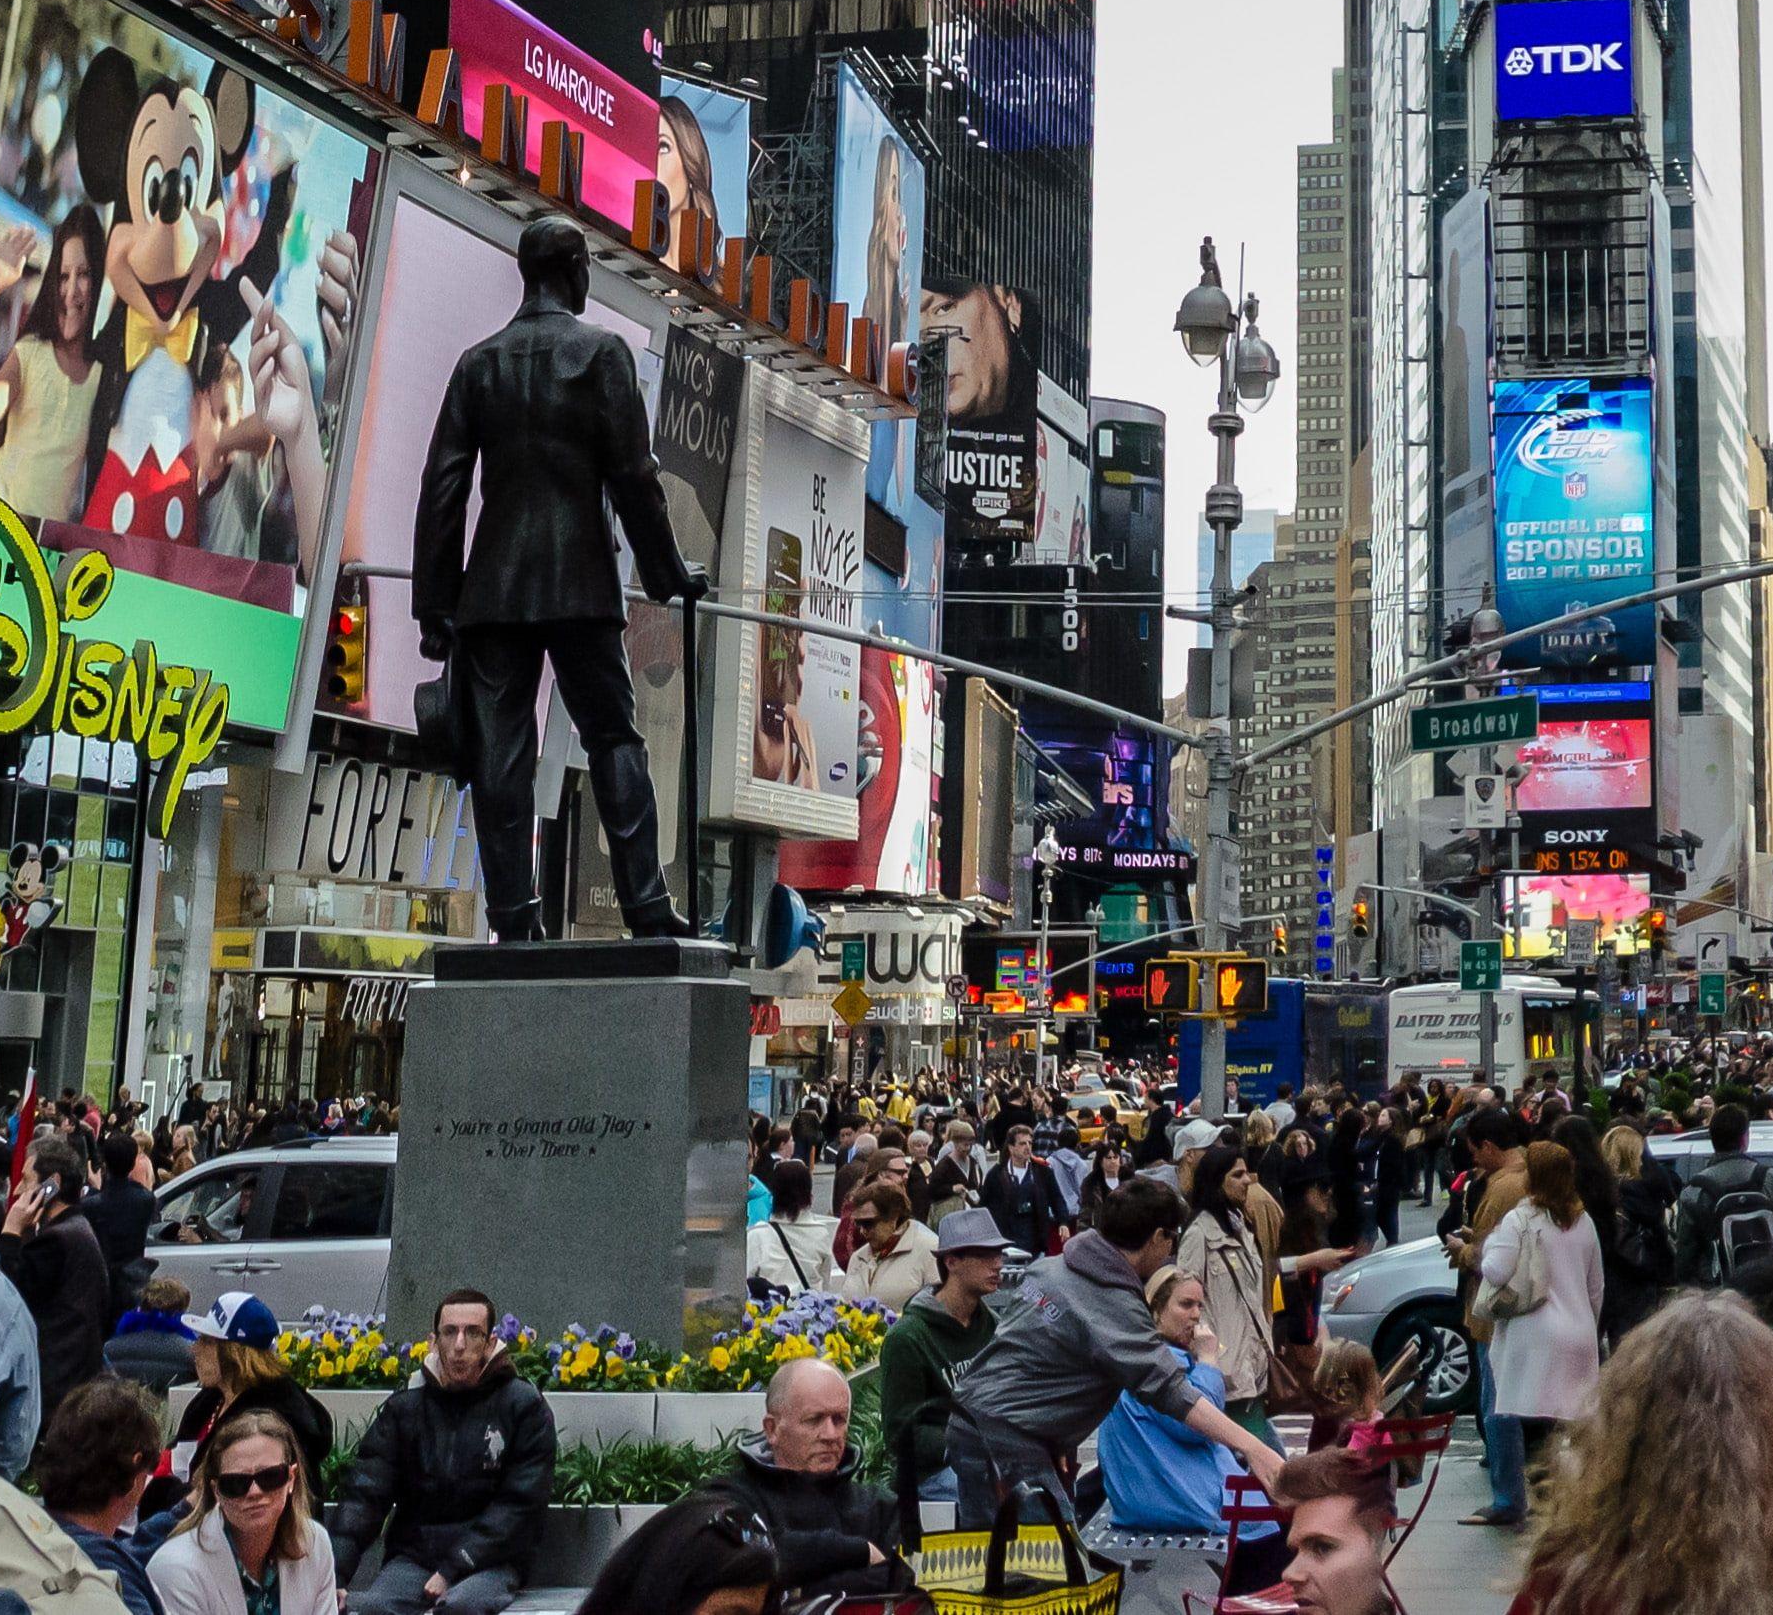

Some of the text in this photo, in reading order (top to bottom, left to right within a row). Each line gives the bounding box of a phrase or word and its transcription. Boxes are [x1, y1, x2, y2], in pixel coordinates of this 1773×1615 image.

[1531, 42, 1624, 74] TDK
[524, 38, 615, 129] LG MARQUEE
[1532, 444, 1618, 460] LIGHT
[1547, 430, 1611, 446] BUD
[813, 473, 827, 515] BE
[1506, 515, 1644, 536] OFFICIAL BEER
[811, 516, 860, 586] NOTE
[1506, 536, 1644, 563] SPONSOR
[809, 576, 853, 629] WORTHY
[1062, 567, 1078, 652] 1500
[1431, 711, 1520, 741] Broadway
[1544, 830, 1609, 844] SONY
[1114, 853, 1175, 868] MONDAYS
